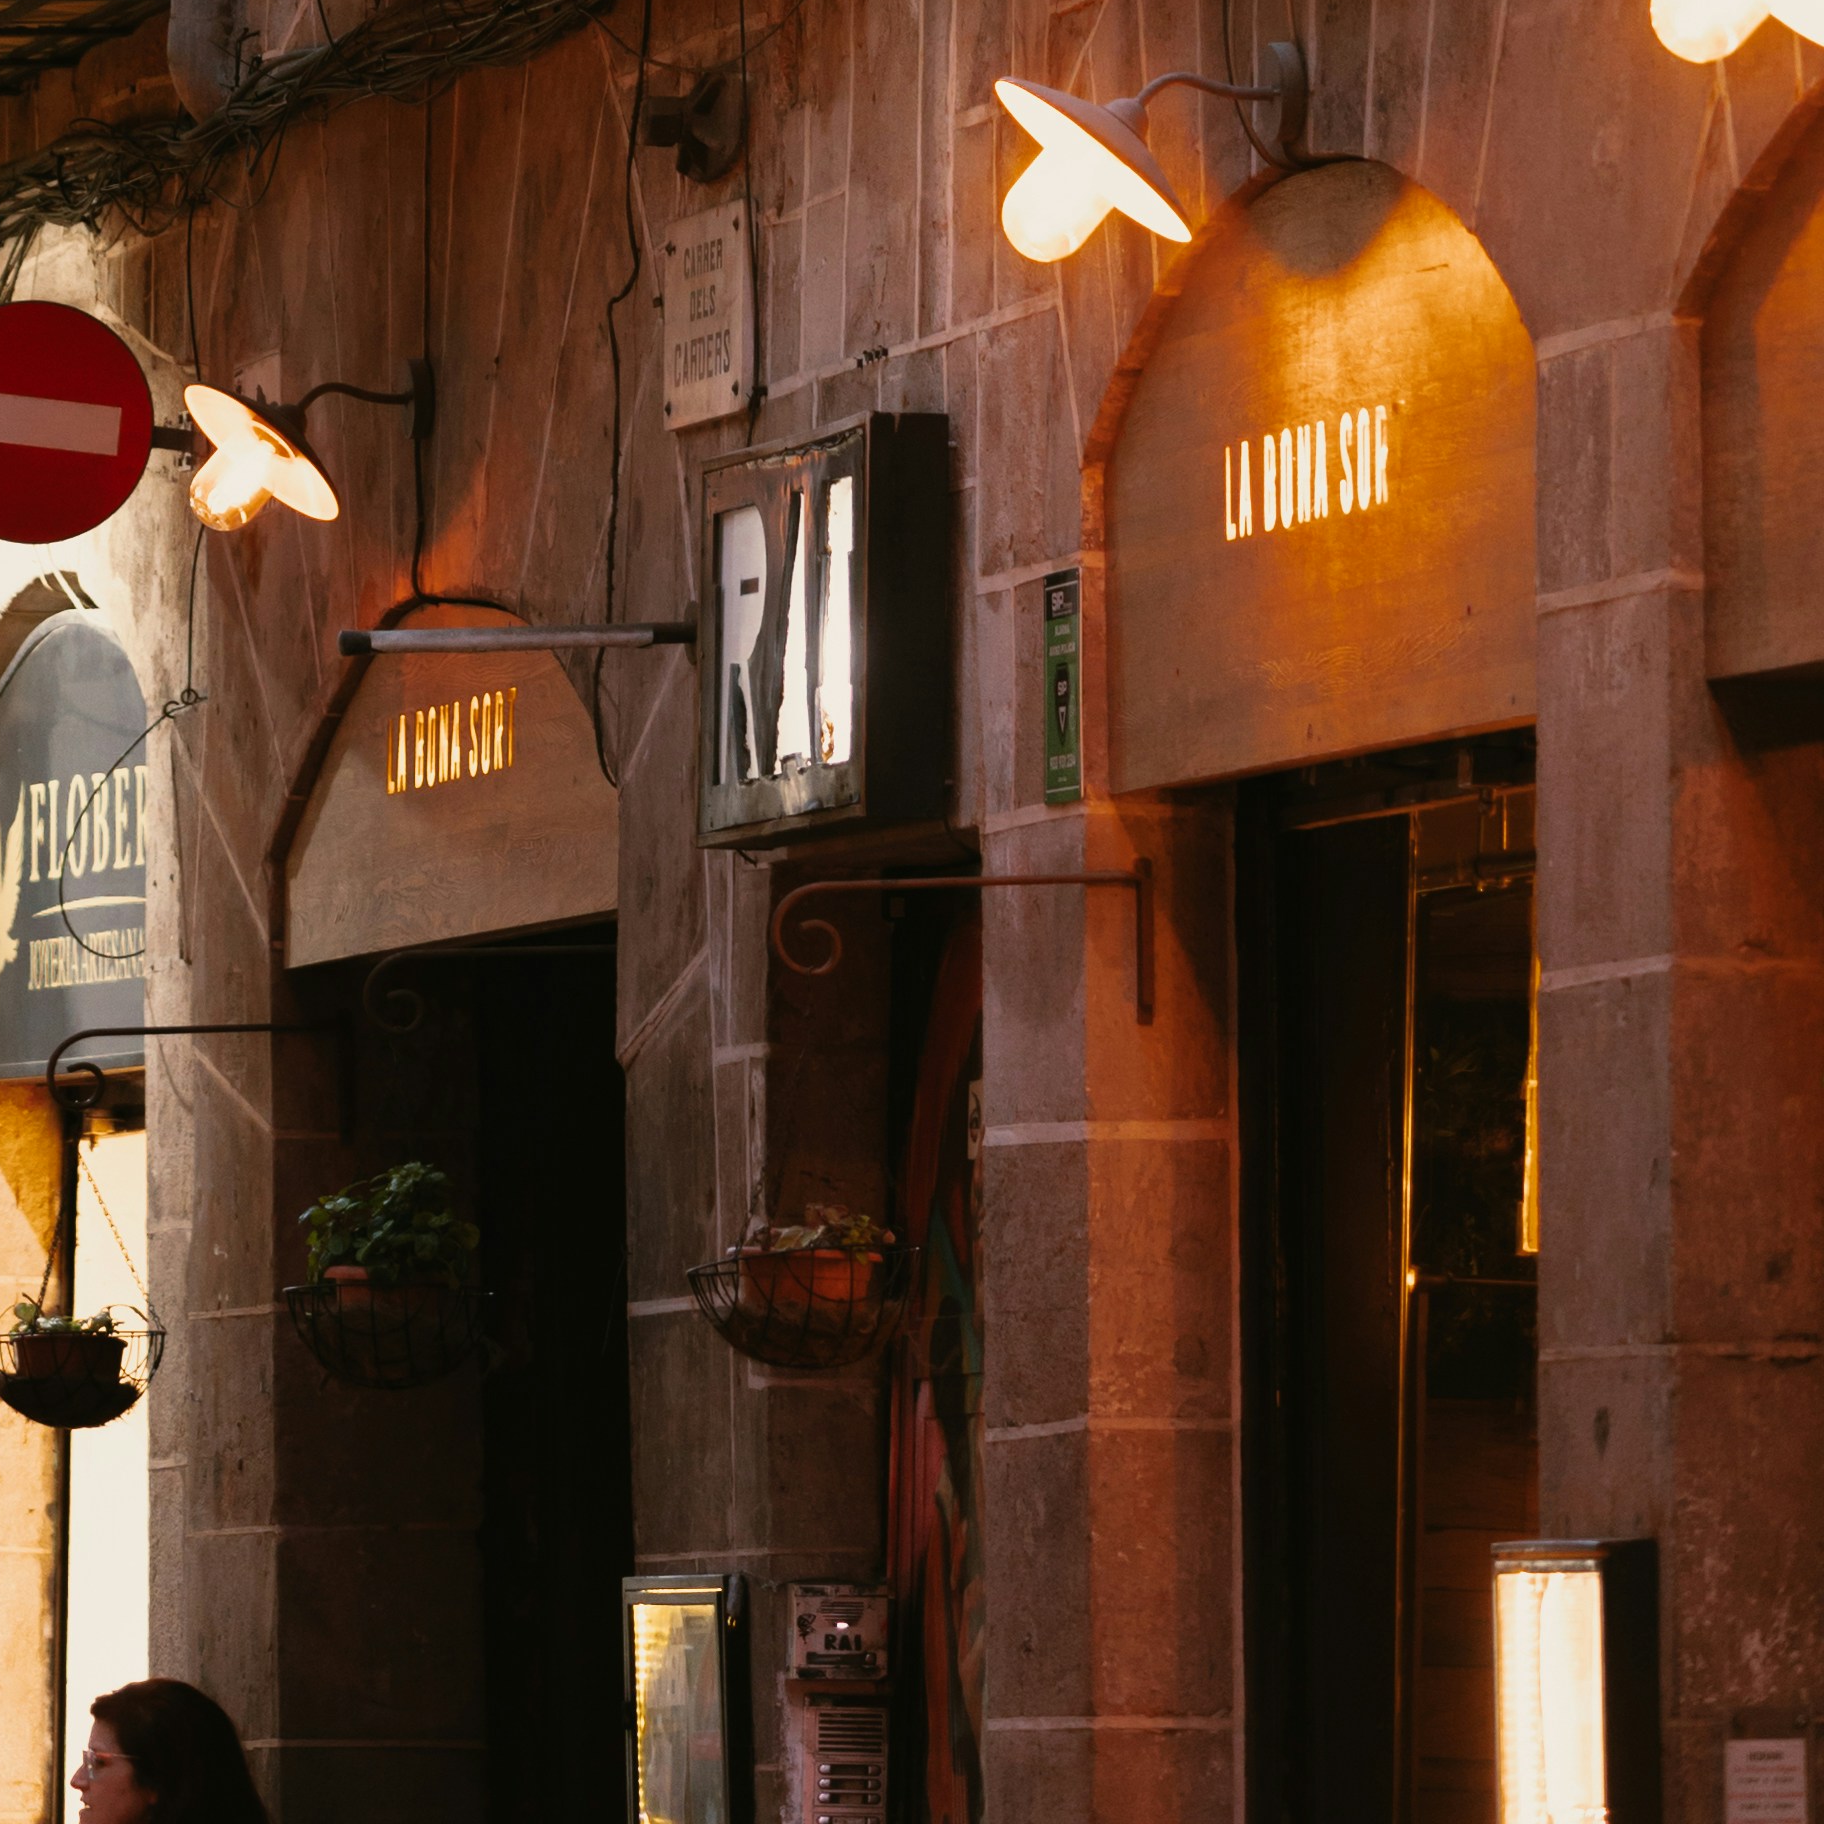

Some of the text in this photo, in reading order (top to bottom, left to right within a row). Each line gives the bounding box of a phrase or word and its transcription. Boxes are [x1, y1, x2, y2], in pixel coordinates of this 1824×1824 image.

[684, 238, 723, 279] CARRER
[689, 285, 716, 322] DELS
[675, 329, 731, 388] CARDERS
[1225, 440, 1253, 541] LA
[1263, 419, 1328, 532] BONA
[387, 687, 517, 795] LA BONA SORT
[824, 1633, 862, 1651] RAI
